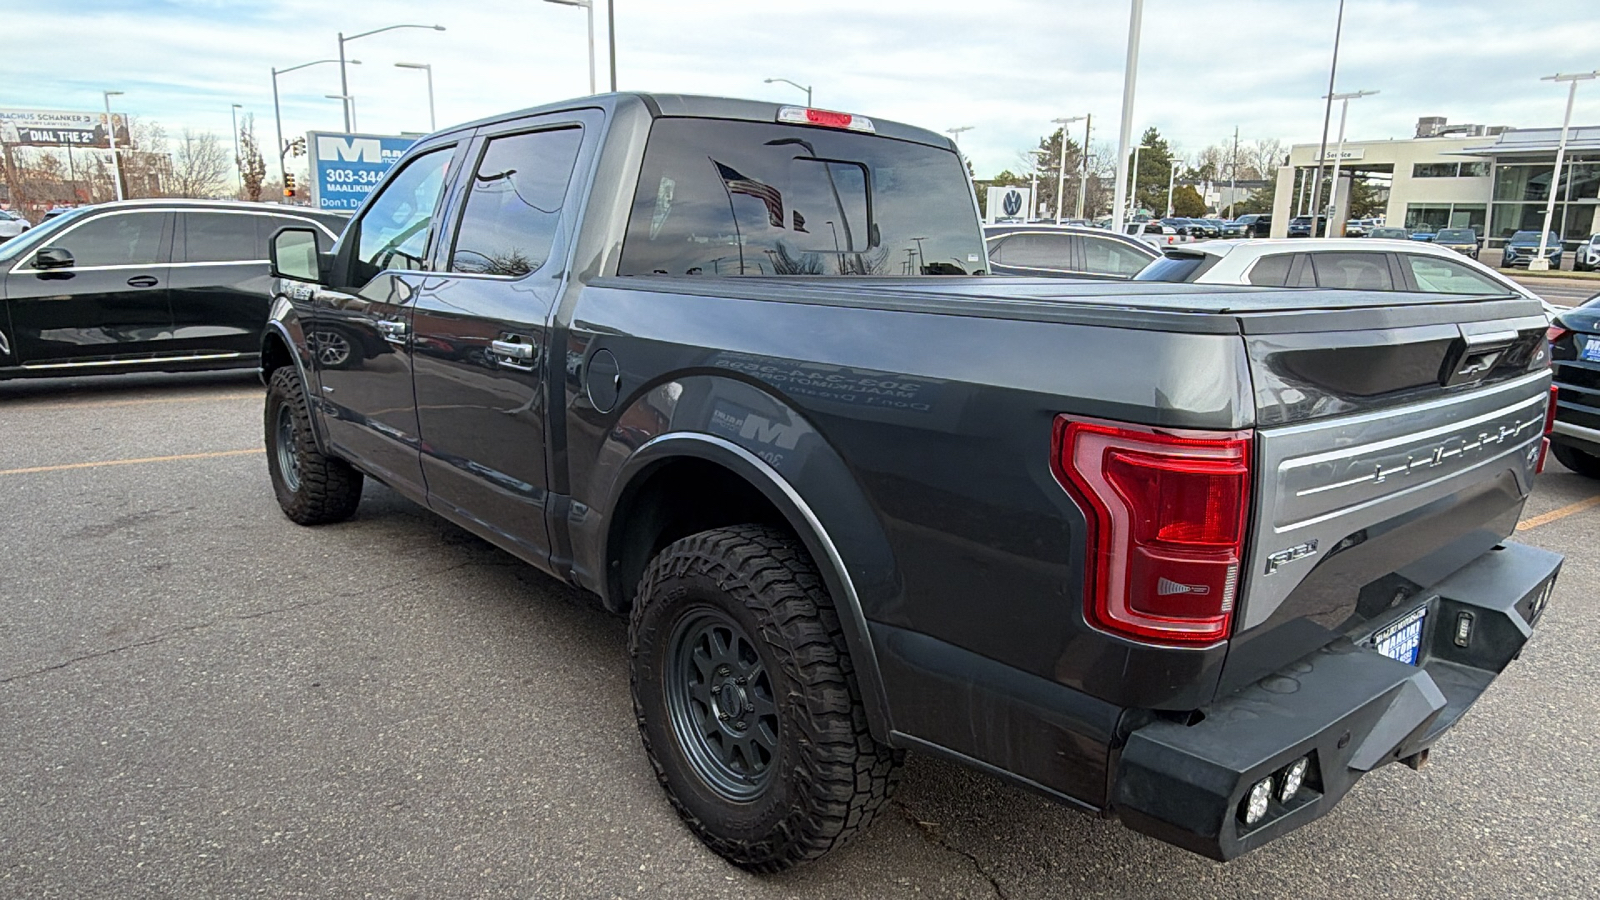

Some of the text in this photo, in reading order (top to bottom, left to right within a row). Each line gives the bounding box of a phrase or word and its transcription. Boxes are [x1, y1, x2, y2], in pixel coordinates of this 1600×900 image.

[37, 114, 81, 122] SCHANKER
[30, 131, 57, 142] DIAL
[58, 132, 80, 142] THE
[1326, 151, 1352, 159] Serice
[321, 198, 348, 208] Don't
